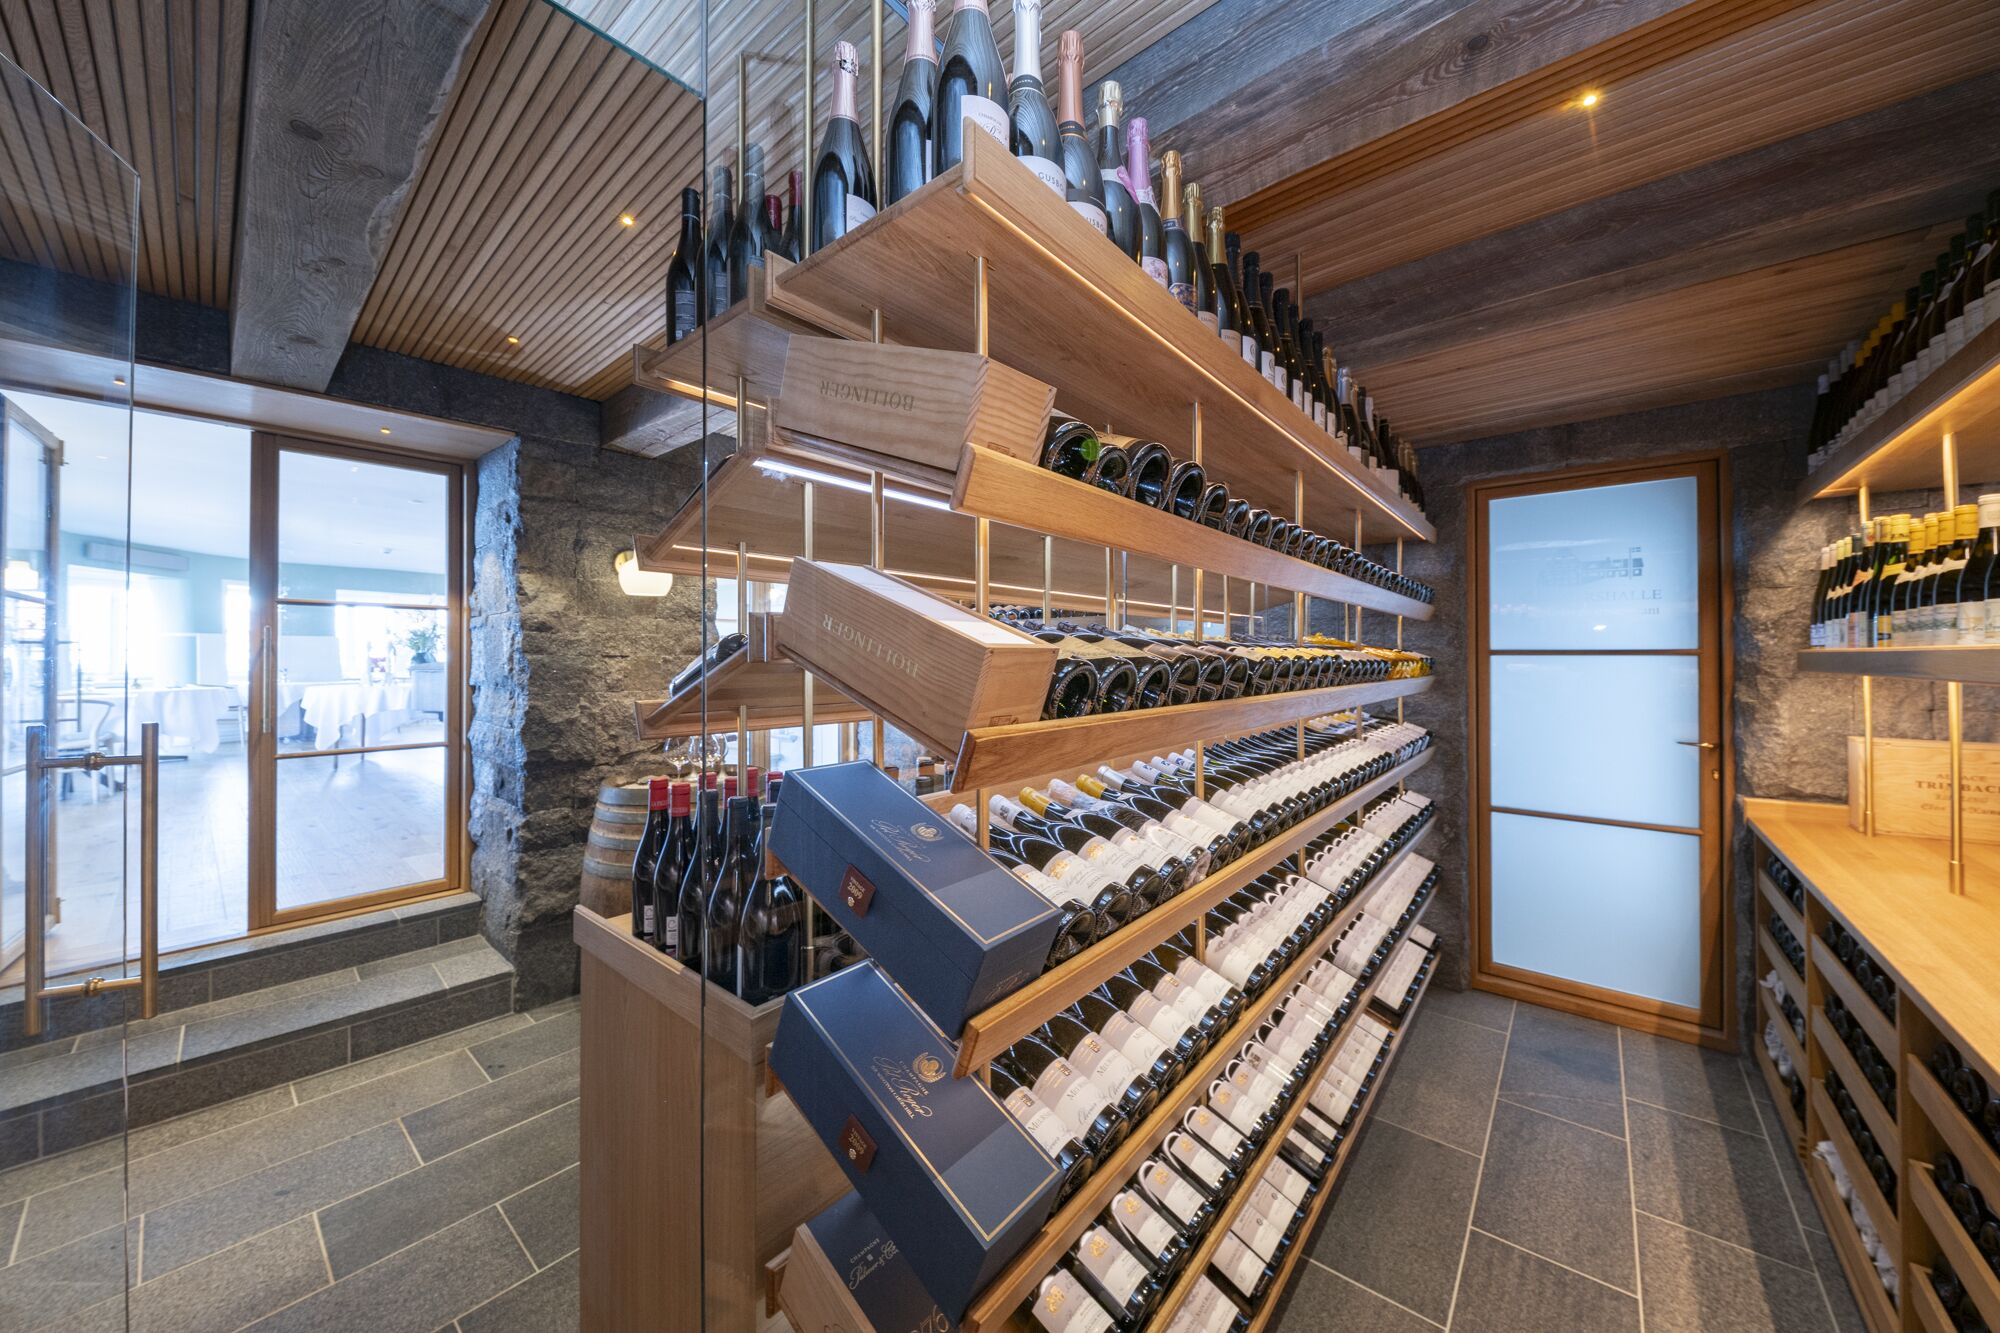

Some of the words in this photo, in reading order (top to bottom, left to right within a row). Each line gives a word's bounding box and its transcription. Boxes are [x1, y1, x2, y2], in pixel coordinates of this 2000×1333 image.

[819, 379, 915, 412] BOLLINGER
[822, 613, 920, 680] BOLLINGER
[1915, 780, 2000, 794] TRIBAC
[849, 1237, 881, 1264] CHAMPAGNE
